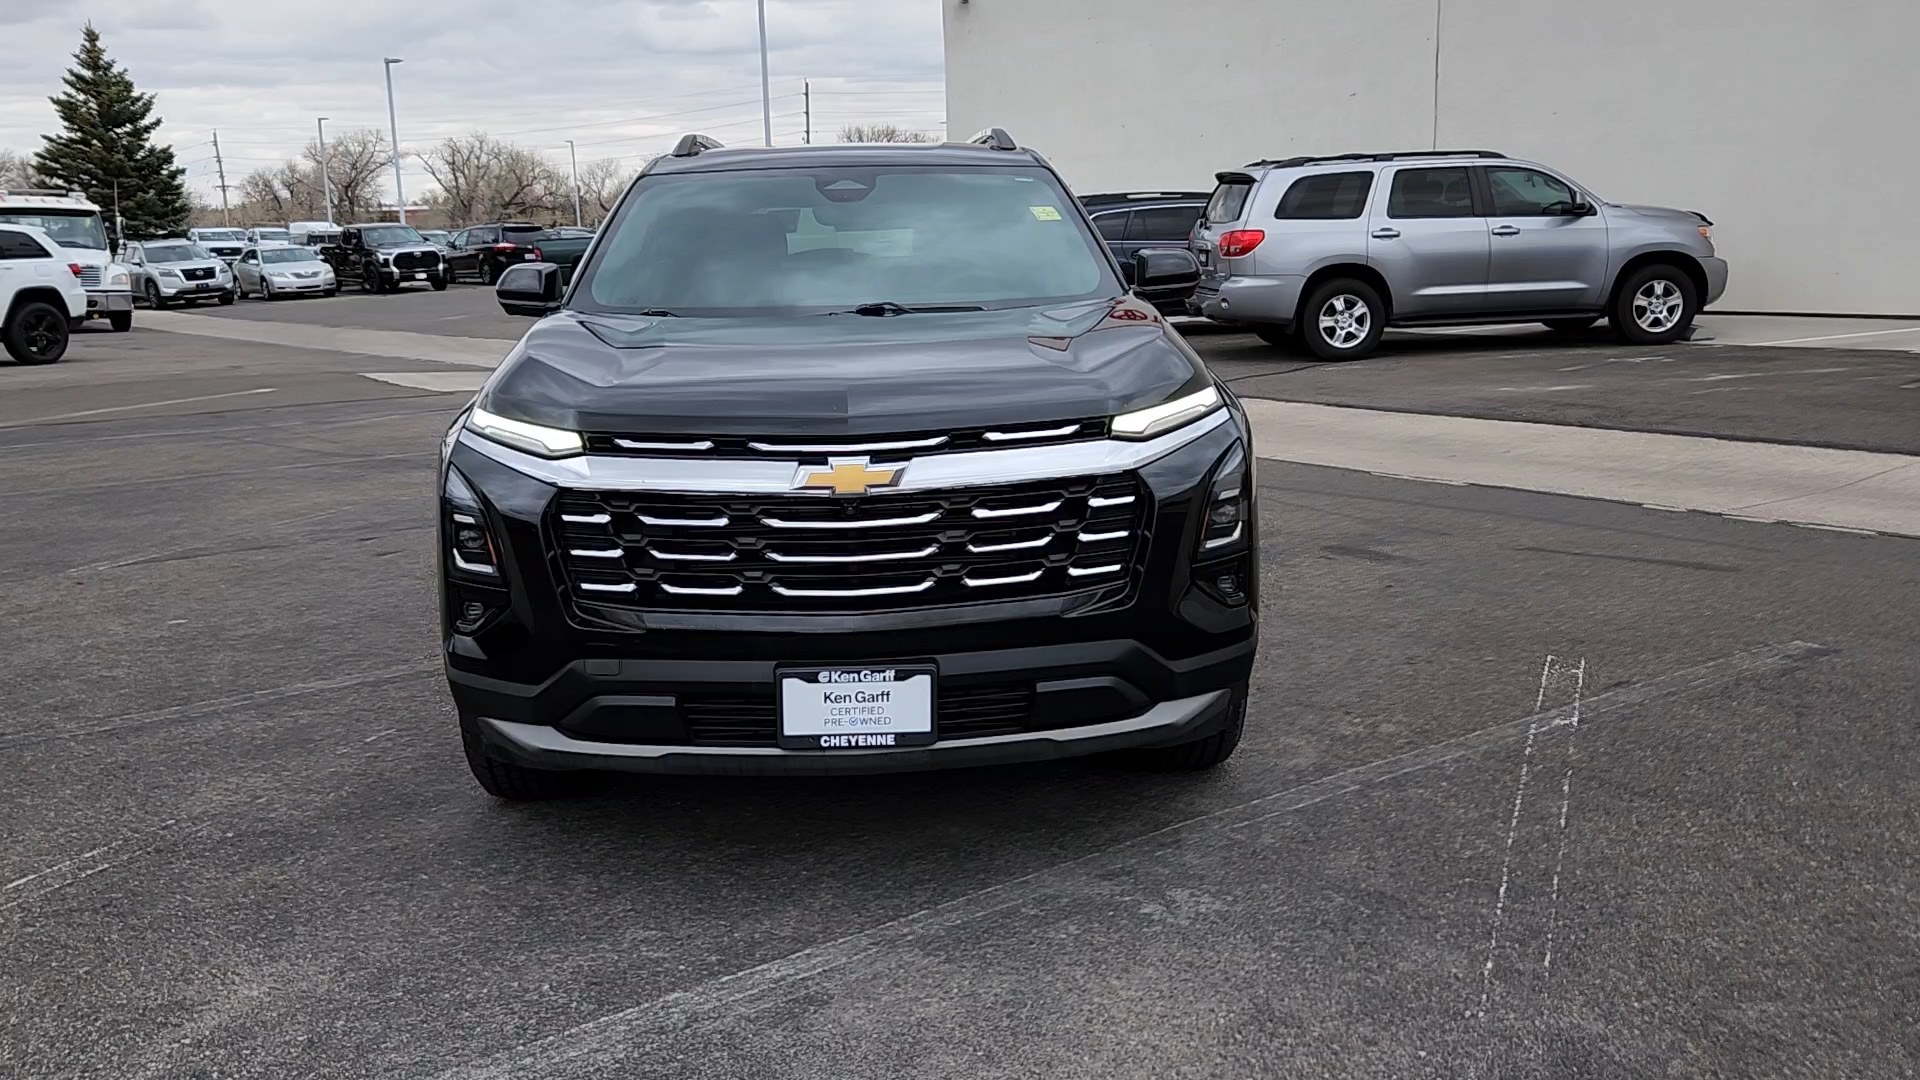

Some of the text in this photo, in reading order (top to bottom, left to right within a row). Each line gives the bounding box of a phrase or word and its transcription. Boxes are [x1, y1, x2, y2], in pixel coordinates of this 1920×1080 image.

[831, 670, 896, 683] Ken Garff
[823, 690, 892, 704] Ken Garff
[830, 706, 885, 716] CERTIFIED
[820, 734, 896, 747] CHEYENNE
